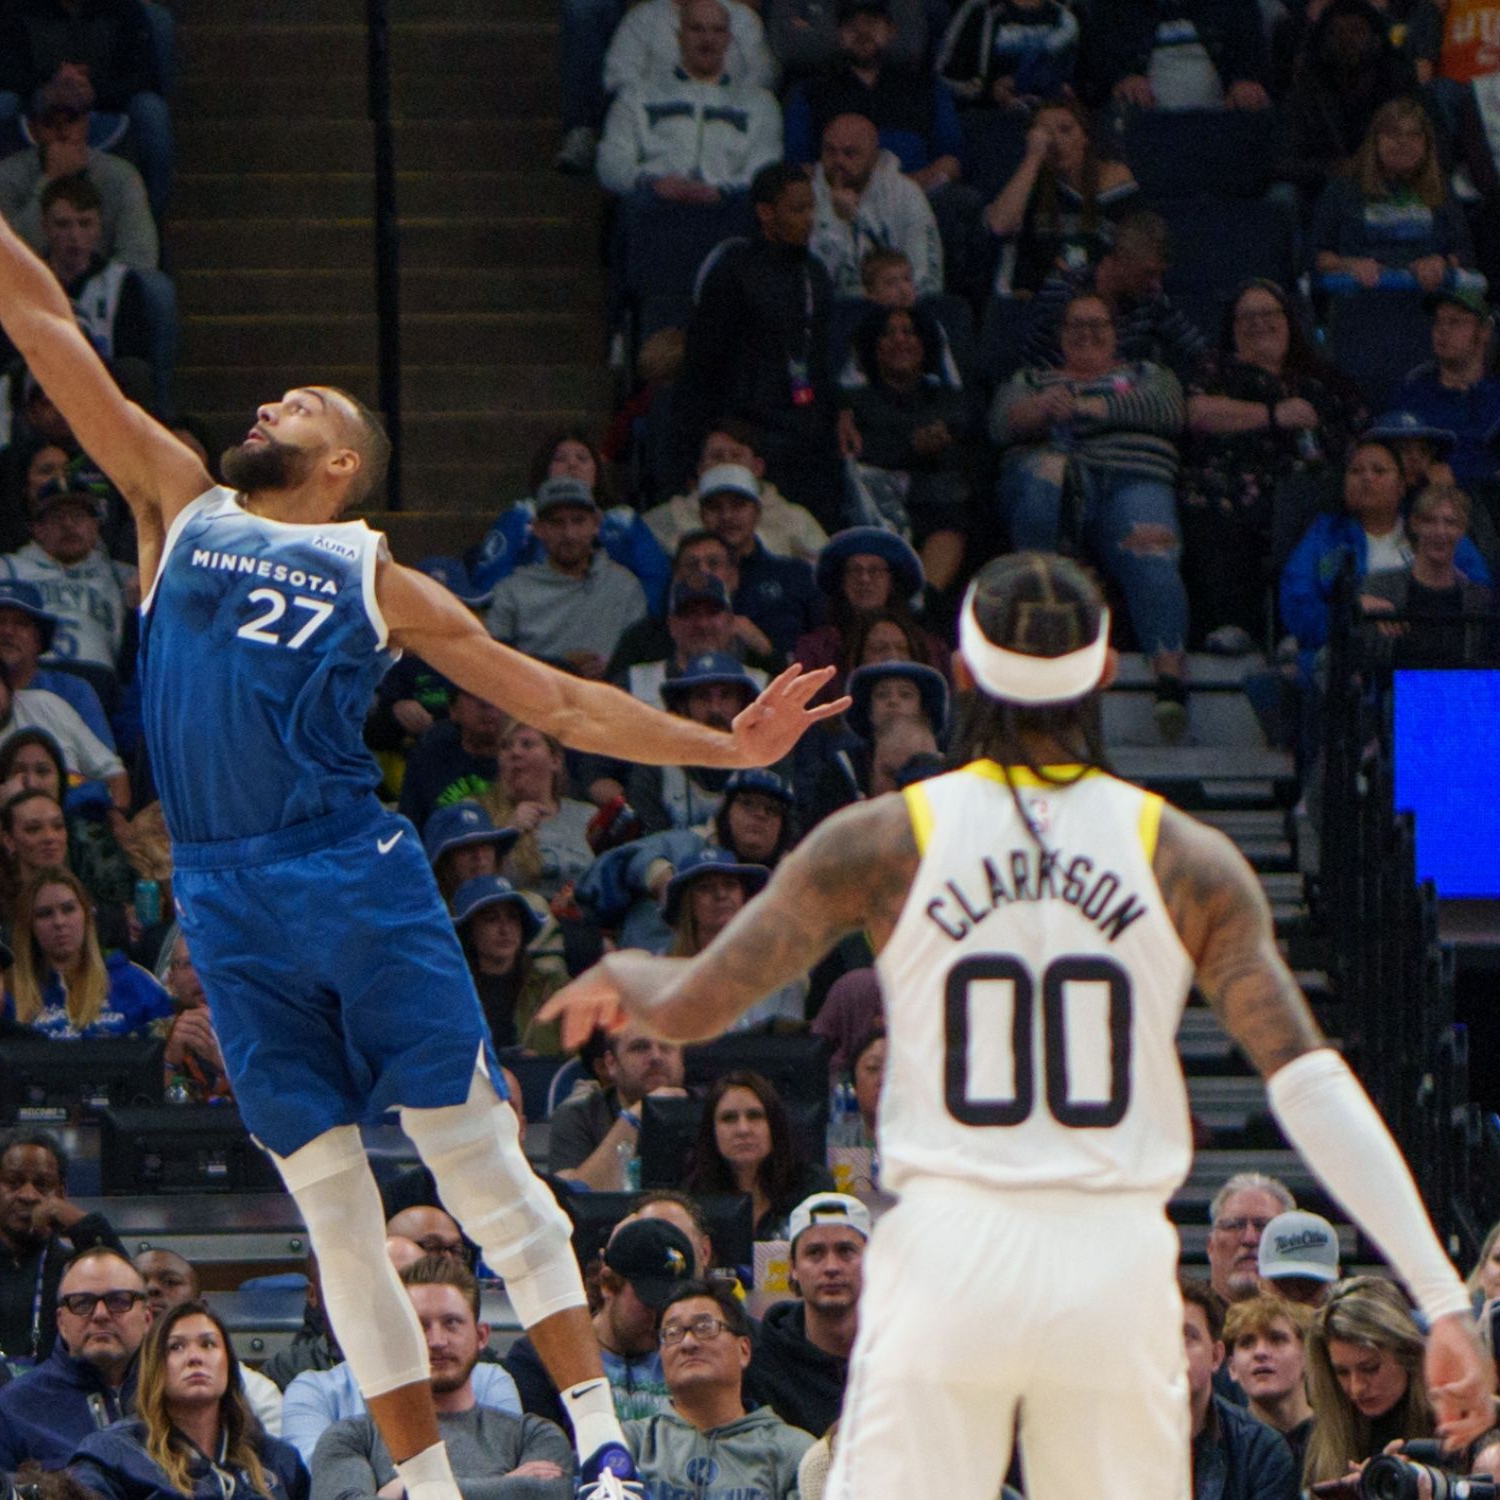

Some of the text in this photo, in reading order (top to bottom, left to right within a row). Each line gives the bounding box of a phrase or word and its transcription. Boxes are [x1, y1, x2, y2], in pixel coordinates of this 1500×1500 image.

[192, 549, 338, 596] MINNESOTA
[237, 588, 335, 650] 27
[926, 850, 1146, 942] CLARKSON
[944, 953, 1132, 1128] 00
